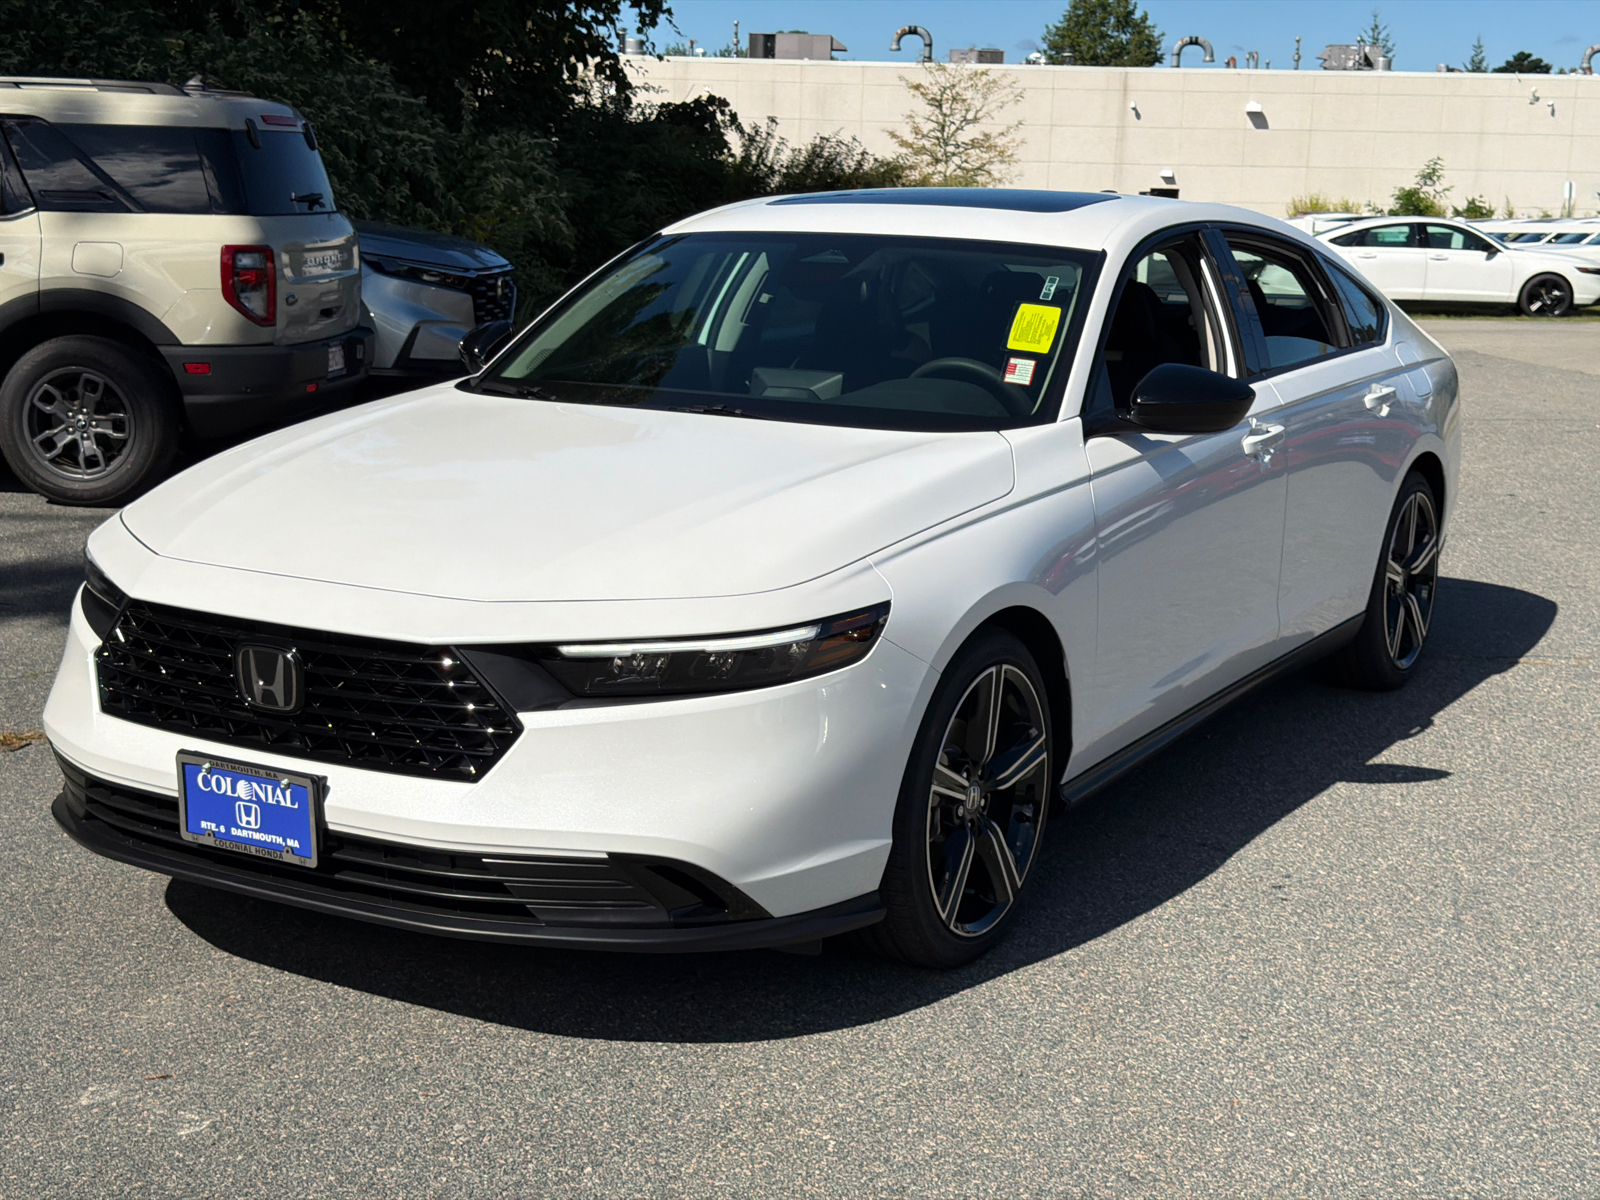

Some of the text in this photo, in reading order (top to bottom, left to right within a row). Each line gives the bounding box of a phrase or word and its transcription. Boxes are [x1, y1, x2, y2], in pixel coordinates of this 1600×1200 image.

[265, 771, 278, 779] MA
[197, 772, 298, 809] COLONIAL
[201, 820, 300, 848] RTE. 6 DARTMOUTH, MA
[214, 839, 284, 860] COLONIAL HONDA
